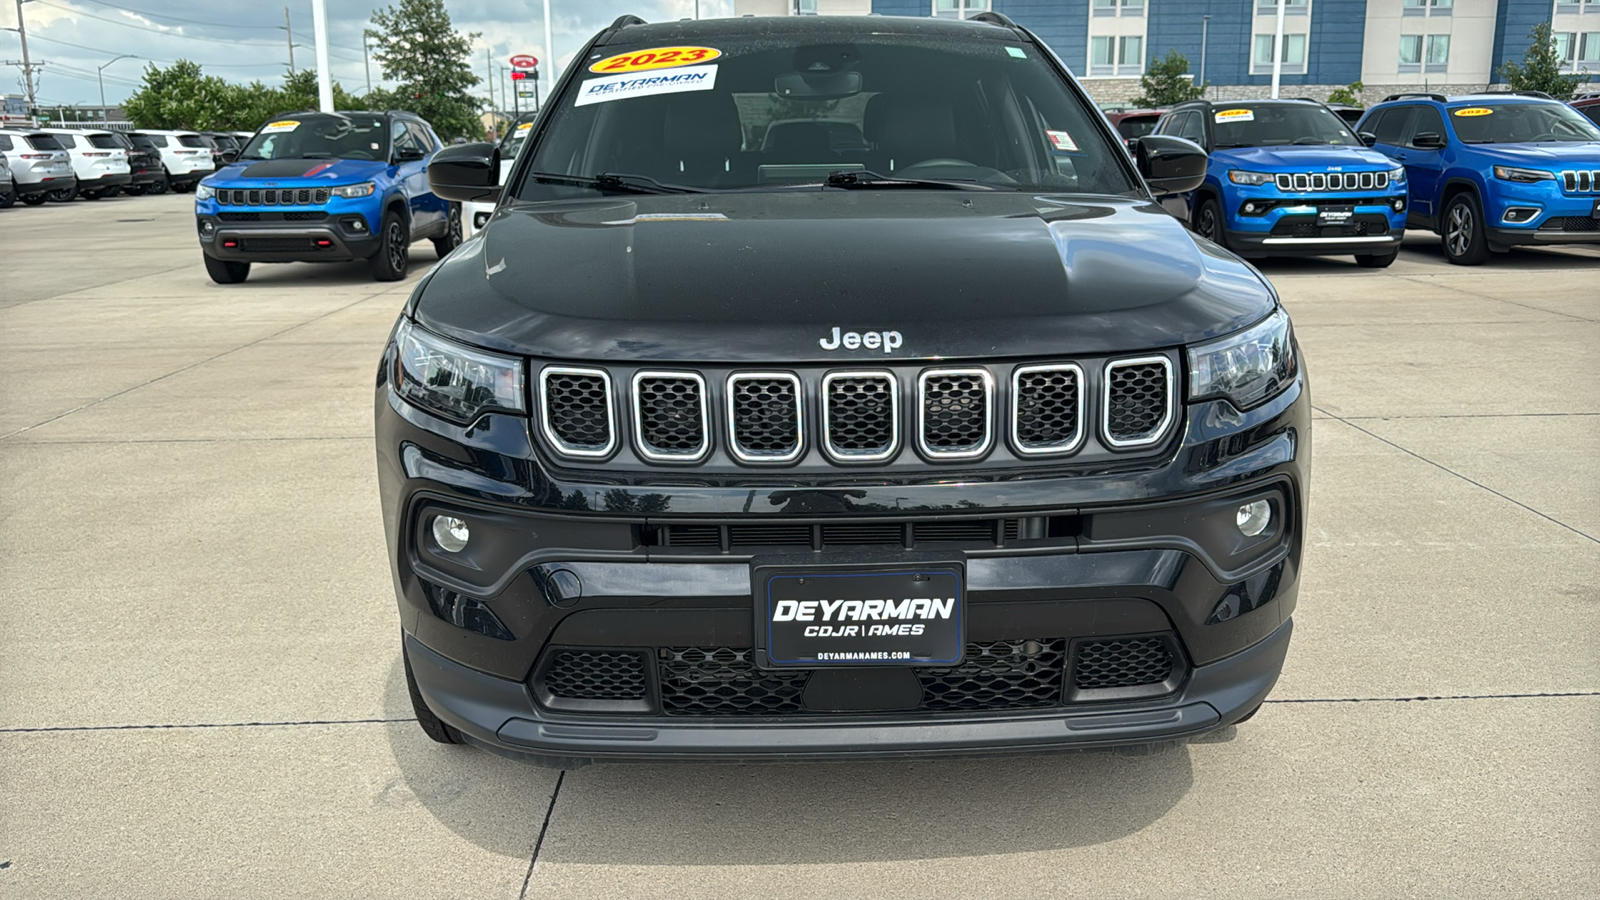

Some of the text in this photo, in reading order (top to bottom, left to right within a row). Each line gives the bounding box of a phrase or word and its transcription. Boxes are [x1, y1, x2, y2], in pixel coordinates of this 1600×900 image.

[602, 49, 709, 71] 2023
[588, 72, 708, 94] DEYARMAN
[595, 79, 703, 96] CERTIFIED PRE-OWNED
[819, 326, 903, 354] Jeep
[772, 598, 955, 622] DEYARMAN
[817, 651, 911, 660] DEYARMANAMES.COM
